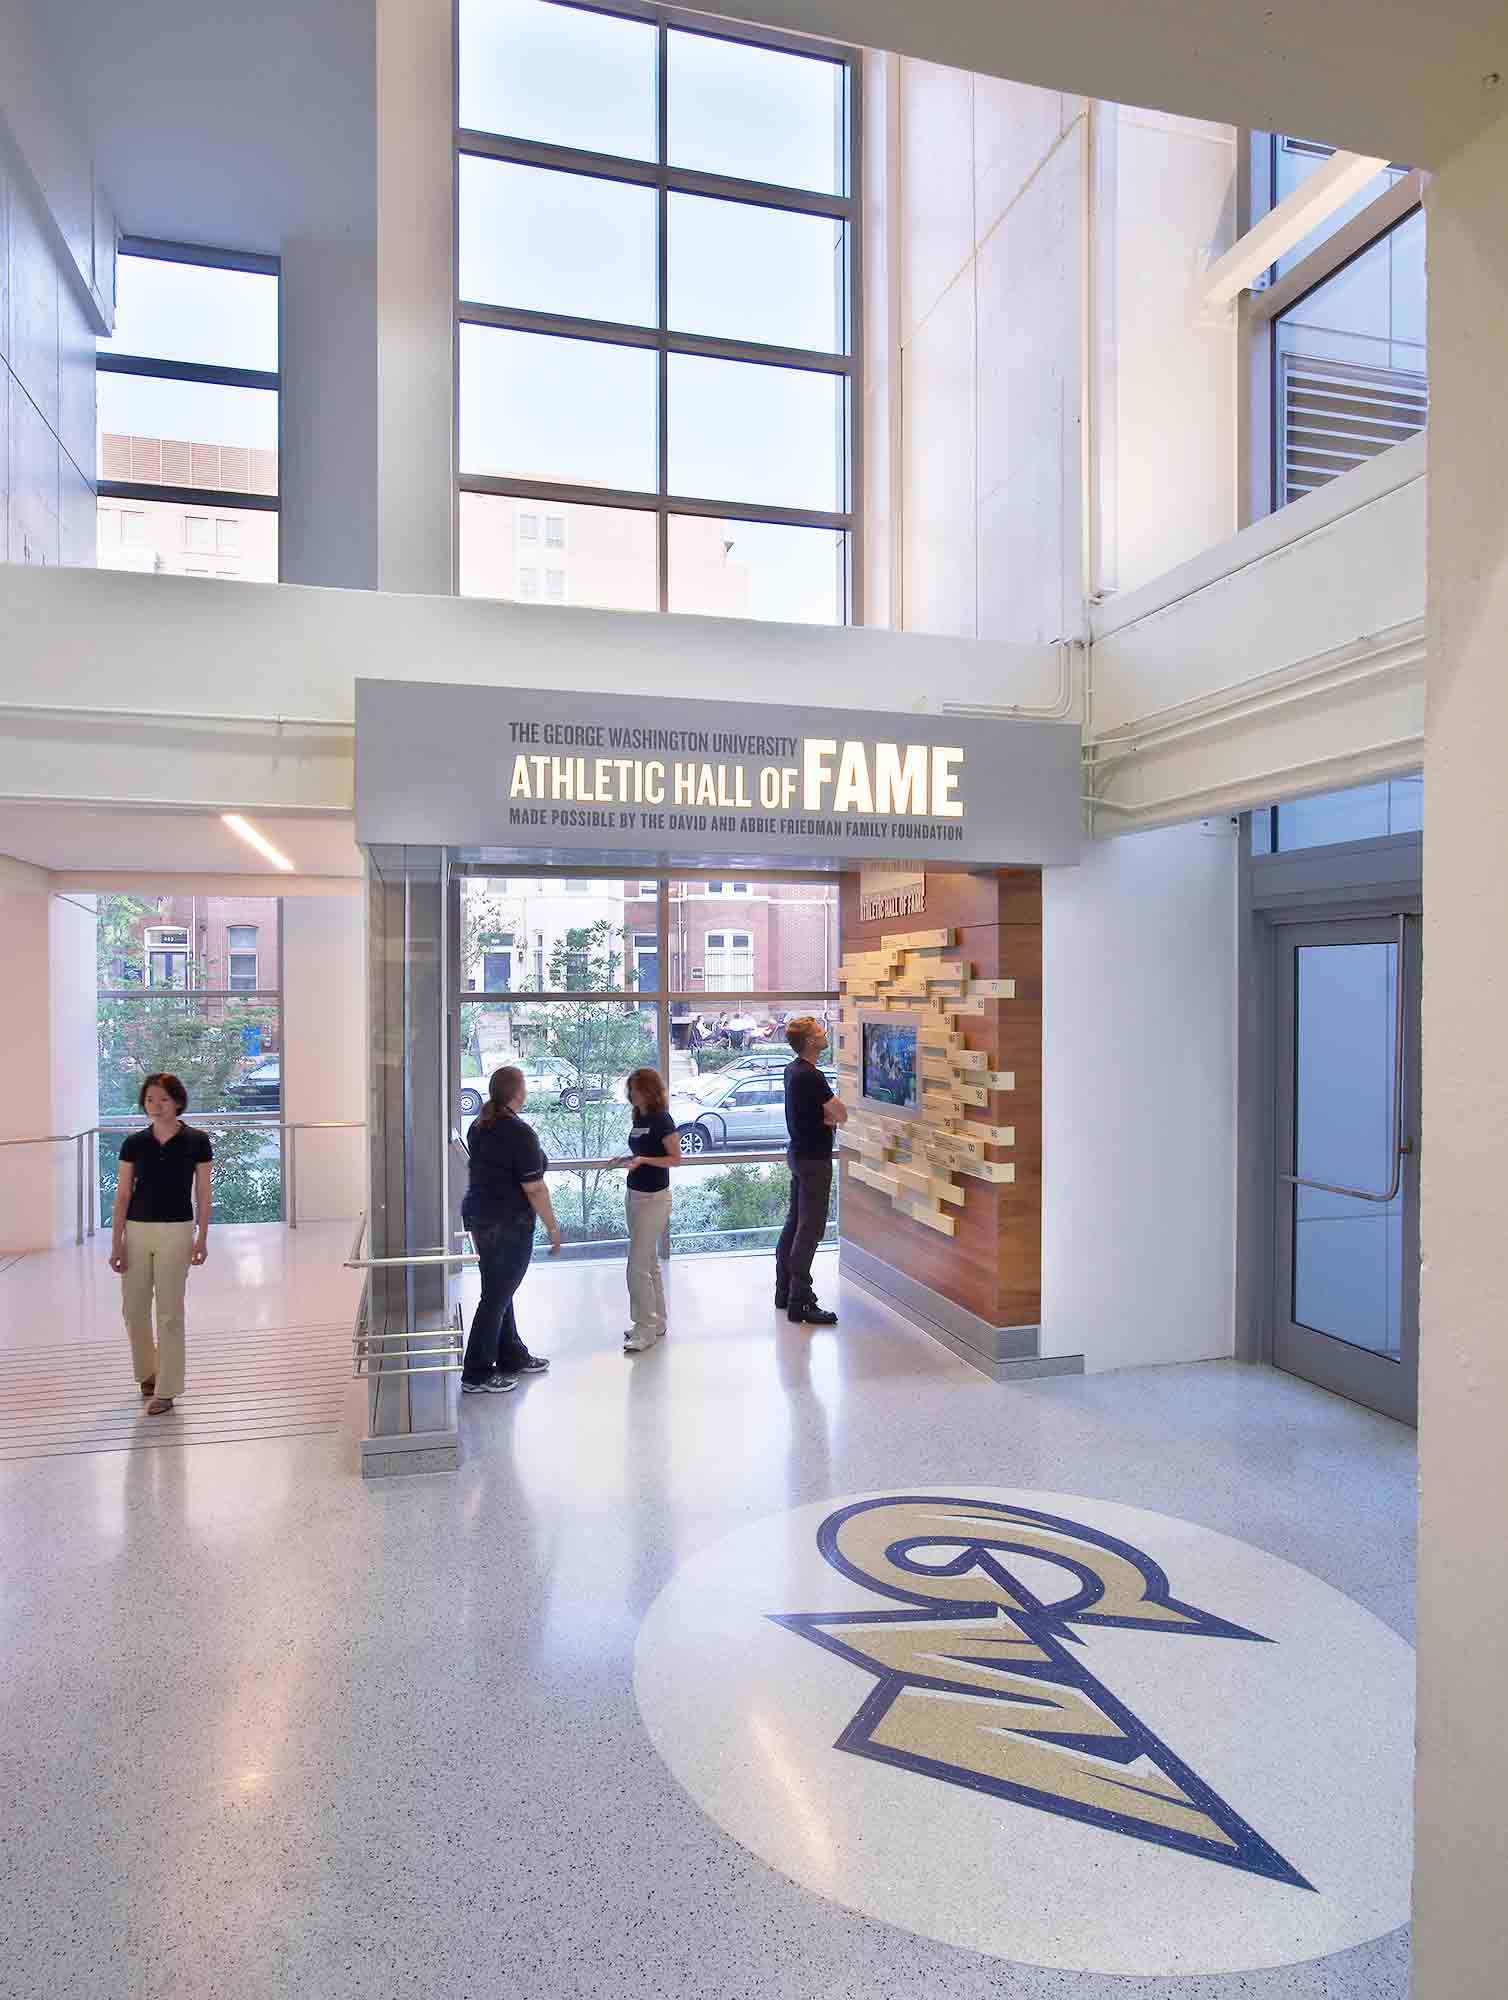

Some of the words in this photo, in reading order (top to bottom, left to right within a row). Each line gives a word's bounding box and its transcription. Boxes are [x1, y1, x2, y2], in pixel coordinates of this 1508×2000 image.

[508, 721, 540, 744] THE
[543, 722, 605, 748] GEORGE
[608, 727, 709, 753] WASHINGTON
[712, 732, 798, 757] UNIVERSITY
[510, 754, 665, 805] ATHLETIC
[674, 762, 753, 808] HALL
[760, 766, 799, 809] OF
[803, 738, 964, 817] FAME
[509, 807, 547, 825] MADE
[551, 808, 616, 828] POSSIBLE
[619, 812, 636, 829] BY
[640, 812, 665, 830] THE
[669, 814, 706, 831] DAVID
[711, 815, 736, 832] AND
[740, 817, 777, 833] ABBIE
[780, 818, 841, 836] FRIEDMAN
[846, 821, 888, 838] FAMILY
[891, 823, 963, 841] FOUNDATION
